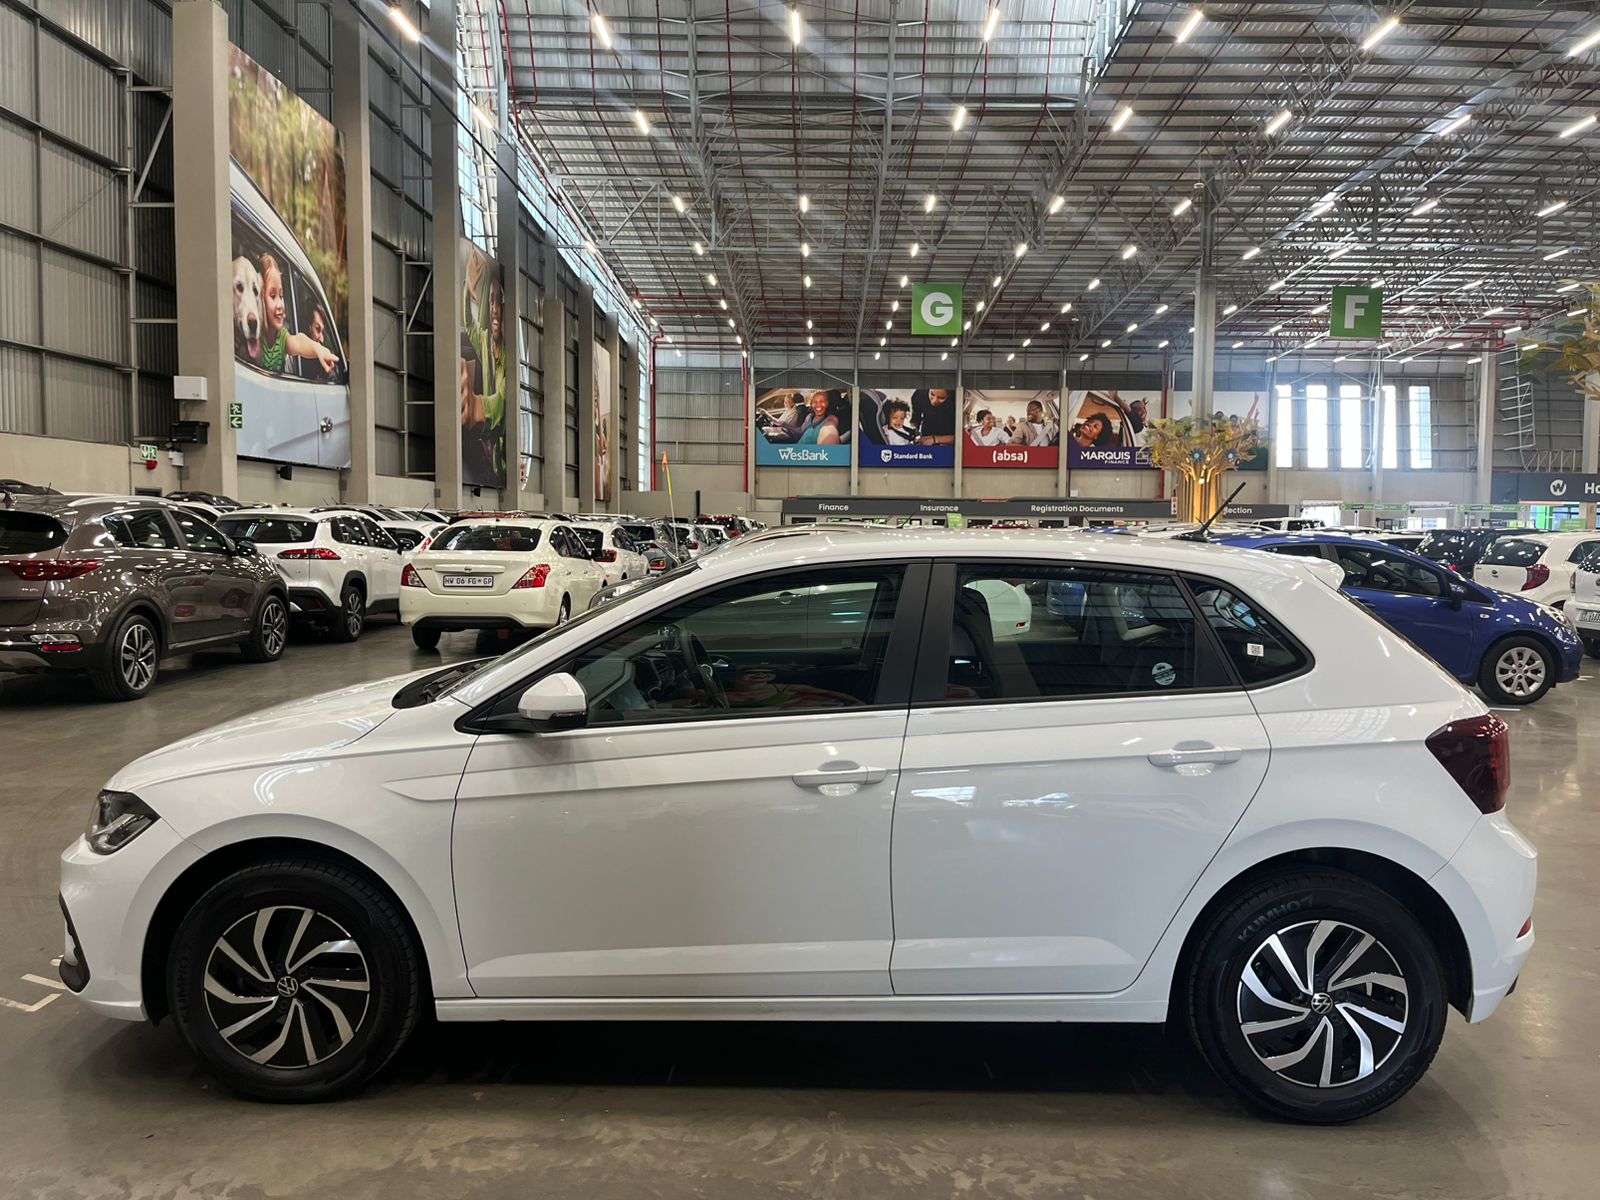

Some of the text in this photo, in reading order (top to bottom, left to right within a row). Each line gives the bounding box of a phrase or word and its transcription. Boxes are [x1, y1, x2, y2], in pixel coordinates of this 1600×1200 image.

[921, 292, 953, 326] G
[1344, 295, 1369, 329] F
[779, 448, 828, 461] WesBank
[893, 452, 933, 460] Standard Bank
[1080, 451, 1131, 461] MARQUIS
[818, 503, 849, 511] Finance
[1031, 504, 1124, 514] Registration Documents
